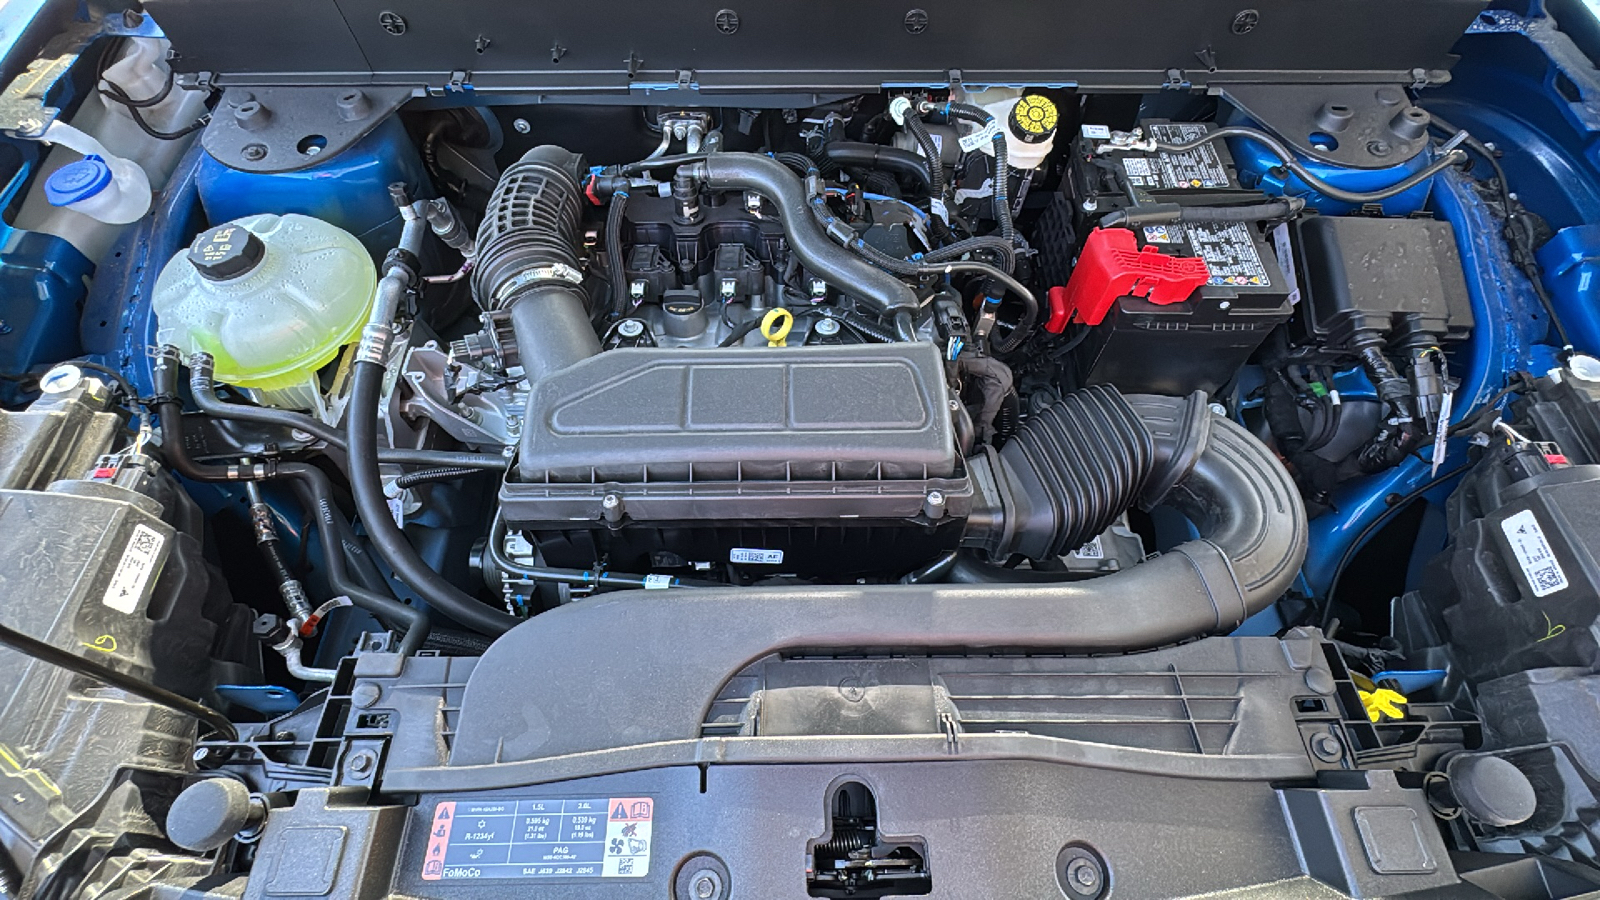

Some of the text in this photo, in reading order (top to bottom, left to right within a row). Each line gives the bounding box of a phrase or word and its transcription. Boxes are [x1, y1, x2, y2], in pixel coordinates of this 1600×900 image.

[532, 803, 546, 811] 1.5L
[542, 817, 550, 826] kg
[588, 816, 597, 825] kg
[465, 832, 495, 841] R-1234yf
[553, 846, 569, 854] PAG
[443, 867, 480, 877] FoMoCo
